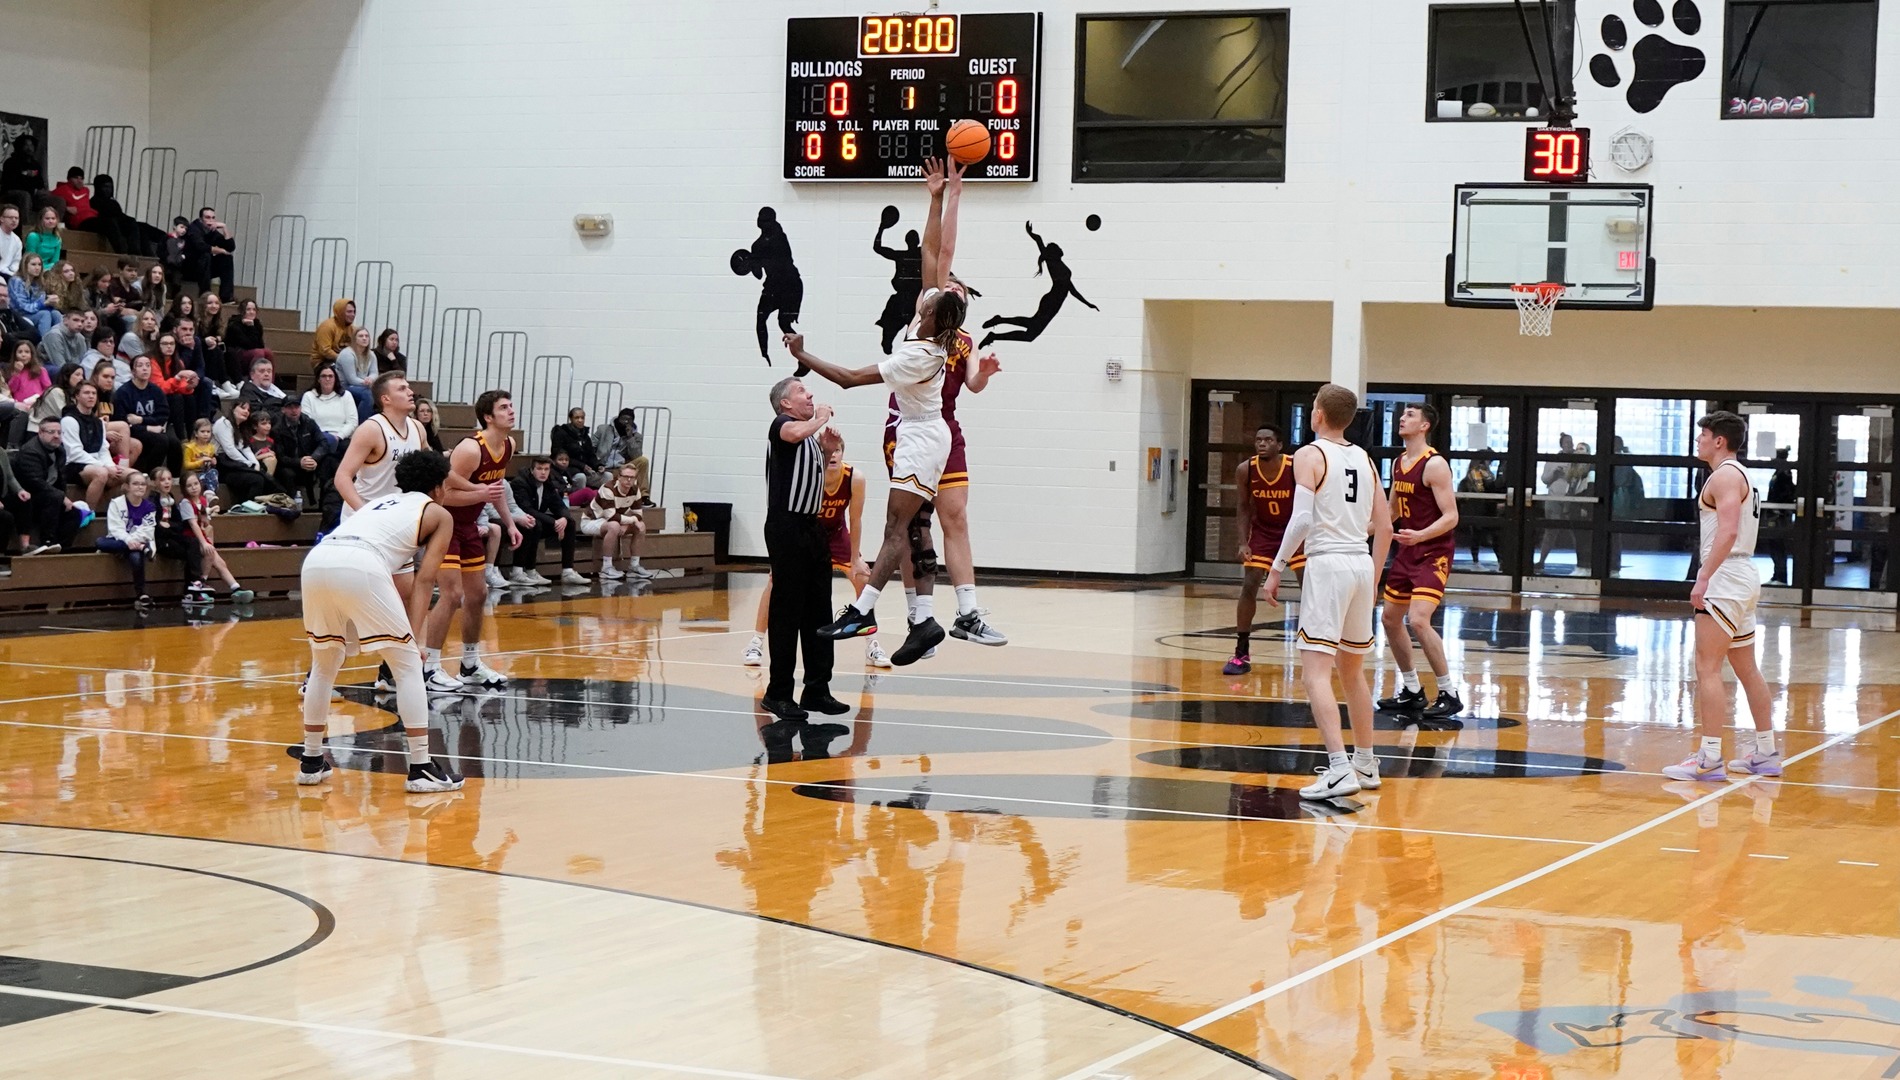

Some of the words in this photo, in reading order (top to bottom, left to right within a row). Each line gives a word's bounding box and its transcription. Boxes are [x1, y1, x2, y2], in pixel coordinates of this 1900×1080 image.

[864, 18, 954, 52] 20:00
[791, 61, 863, 78] BULLDOGS
[890, 68, 925, 80] PERIOD
[968, 58, 1017, 75] GUEST
[829, 82, 849, 116] 0
[908, 86, 915, 110] 1
[997, 79, 1017, 114] 0
[795, 120, 827, 132] FOULS
[837, 120, 863, 132] T.O.L.
[873, 119, 909, 131] PLAYER
[915, 119, 940, 131] FOUL
[988, 118, 1020, 130] FOULS
[806, 133, 822, 160] 0
[841, 133, 857, 160] 6
[999, 132, 1015, 159] 0
[1533, 134, 1580, 174] 30
[794, 165, 826, 177] SCORE
[888, 165, 922, 177] MATCH
[986, 165, 1019, 177] SCORE
[1618, 250, 1641, 269] EXIT
[956, 338, 970, 357] LVIN
[1252, 489, 1290, 498] CALVIN
[1345, 469, 1358, 503] 3
[1268, 501, 1280, 515] 0
[1398, 497, 1411, 518] 15
